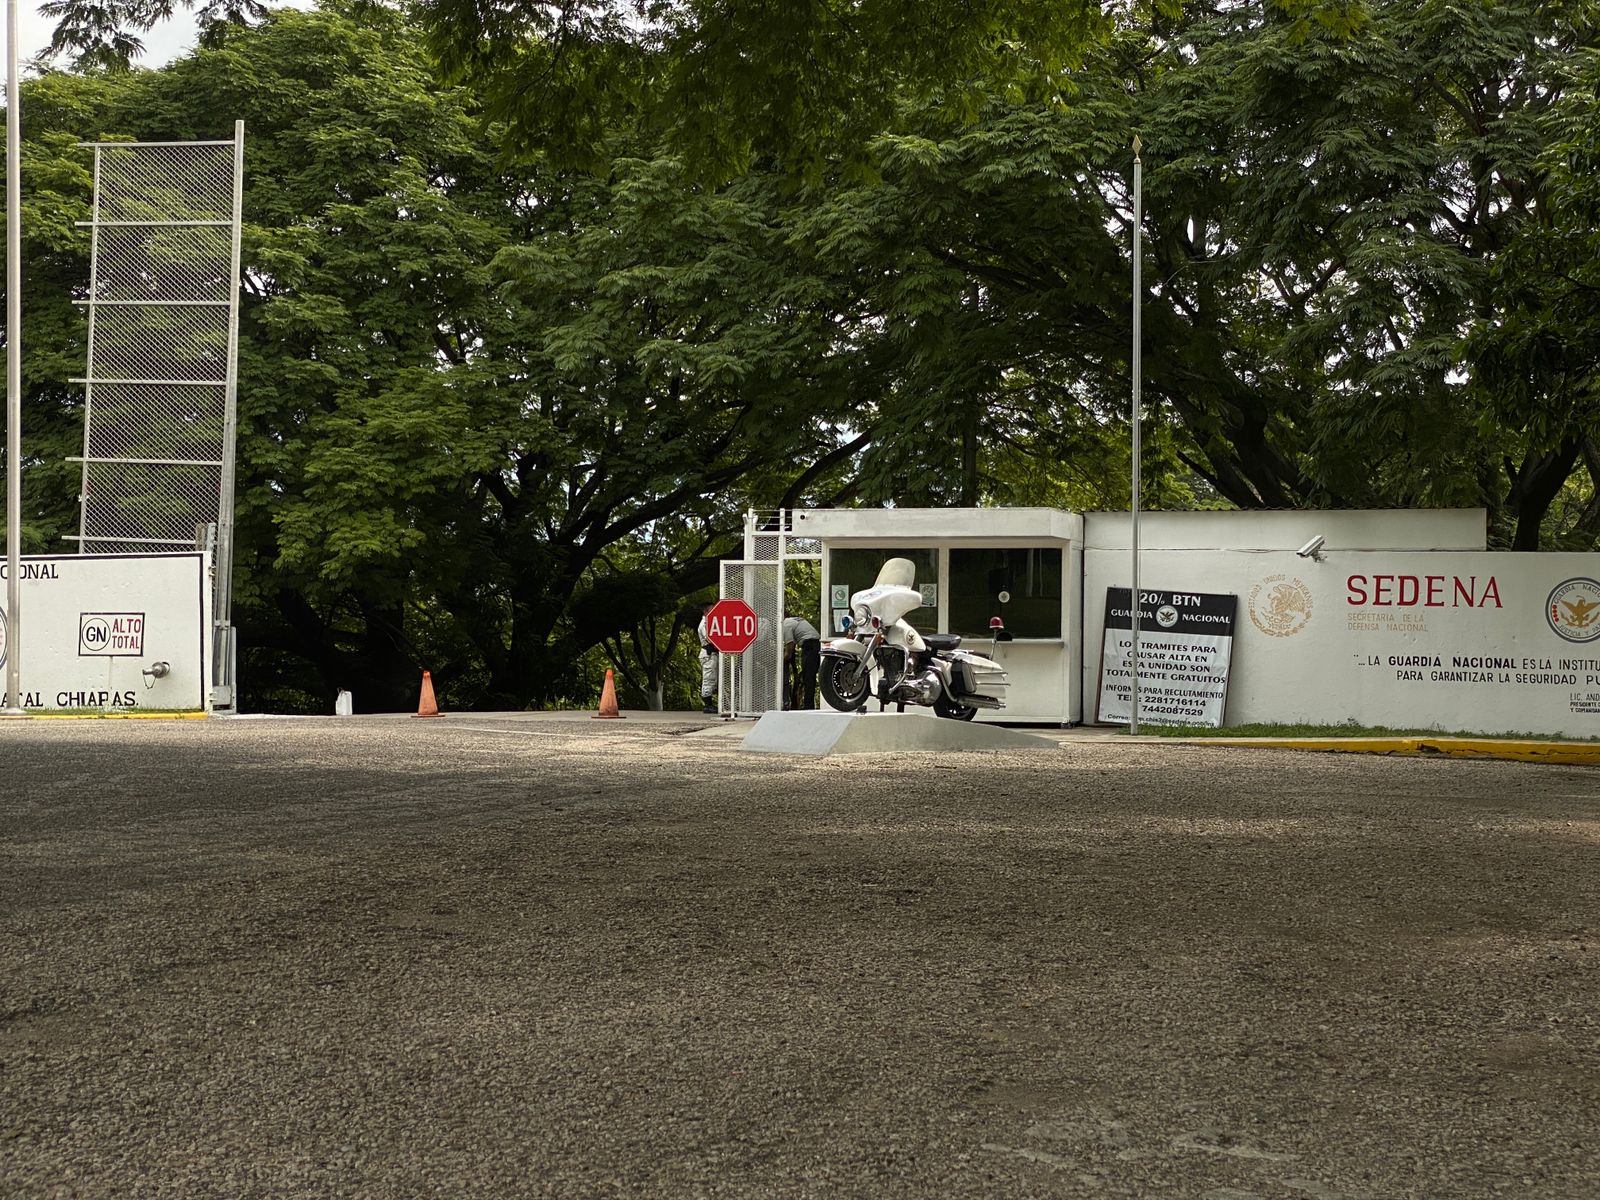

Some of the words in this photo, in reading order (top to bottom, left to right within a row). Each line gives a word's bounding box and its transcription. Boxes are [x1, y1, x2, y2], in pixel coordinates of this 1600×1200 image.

[1347, 575, 1503, 608] SEDENA
[1172, 594, 1201, 607] BTN
[1111, 609, 1153, 619] GUADIA
[1182, 614, 1231, 624] NACIONAL
[1347, 613, 1395, 622] SECRETARIA
[1403, 614, 1411, 622] DE
[1414, 614, 1424, 622] LA
[112, 618, 141, 633] ALTO
[709, 616, 755, 636] ALTO
[1348, 622, 1380, 631] DEFENSA
[1387, 623, 1428, 632] NACIONAL
[86, 626, 107, 642] GN
[112, 636, 140, 649] TOTAL
[1119, 640, 1132, 648] LO
[1141, 642, 1188, 652] TRAMITES
[1191, 645, 1217, 653] PARA
[1168, 654, 1192, 662] ALTA
[1388, 655, 1441, 667] GUARDIA
[1452, 656, 1517, 669] NACIONAL
[1523, 658, 1536, 669] ES
[1539, 659, 1552, 669] LA
[1559, 659, 1600, 671] INSTITU
[1122, 660, 1145, 668] ESA
[1148, 662, 1187, 671] UNIDAD
[1190, 665, 1210, 673] SON
[1105, 669, 1167, 680] TOTAMENTE
[1170, 673, 1226, 683] GRATUITOS
[1397, 670, 1423, 681] PARA
[1431, 671, 1493, 682] GARANTIZAR
[1499, 673, 1510, 683] LA
[1516, 673, 1576, 685] SEGURIDAD
[0, 692, 43, 707] AAL
[57, 691, 139, 707] CHIAPAS.
[1143, 687, 1162, 695] PARA
[1164, 688, 1224, 699] RECLUTAMIENTO
[1145, 696, 1206, 706] 2281716114
[1142, 705, 1204, 716] 7442087529
